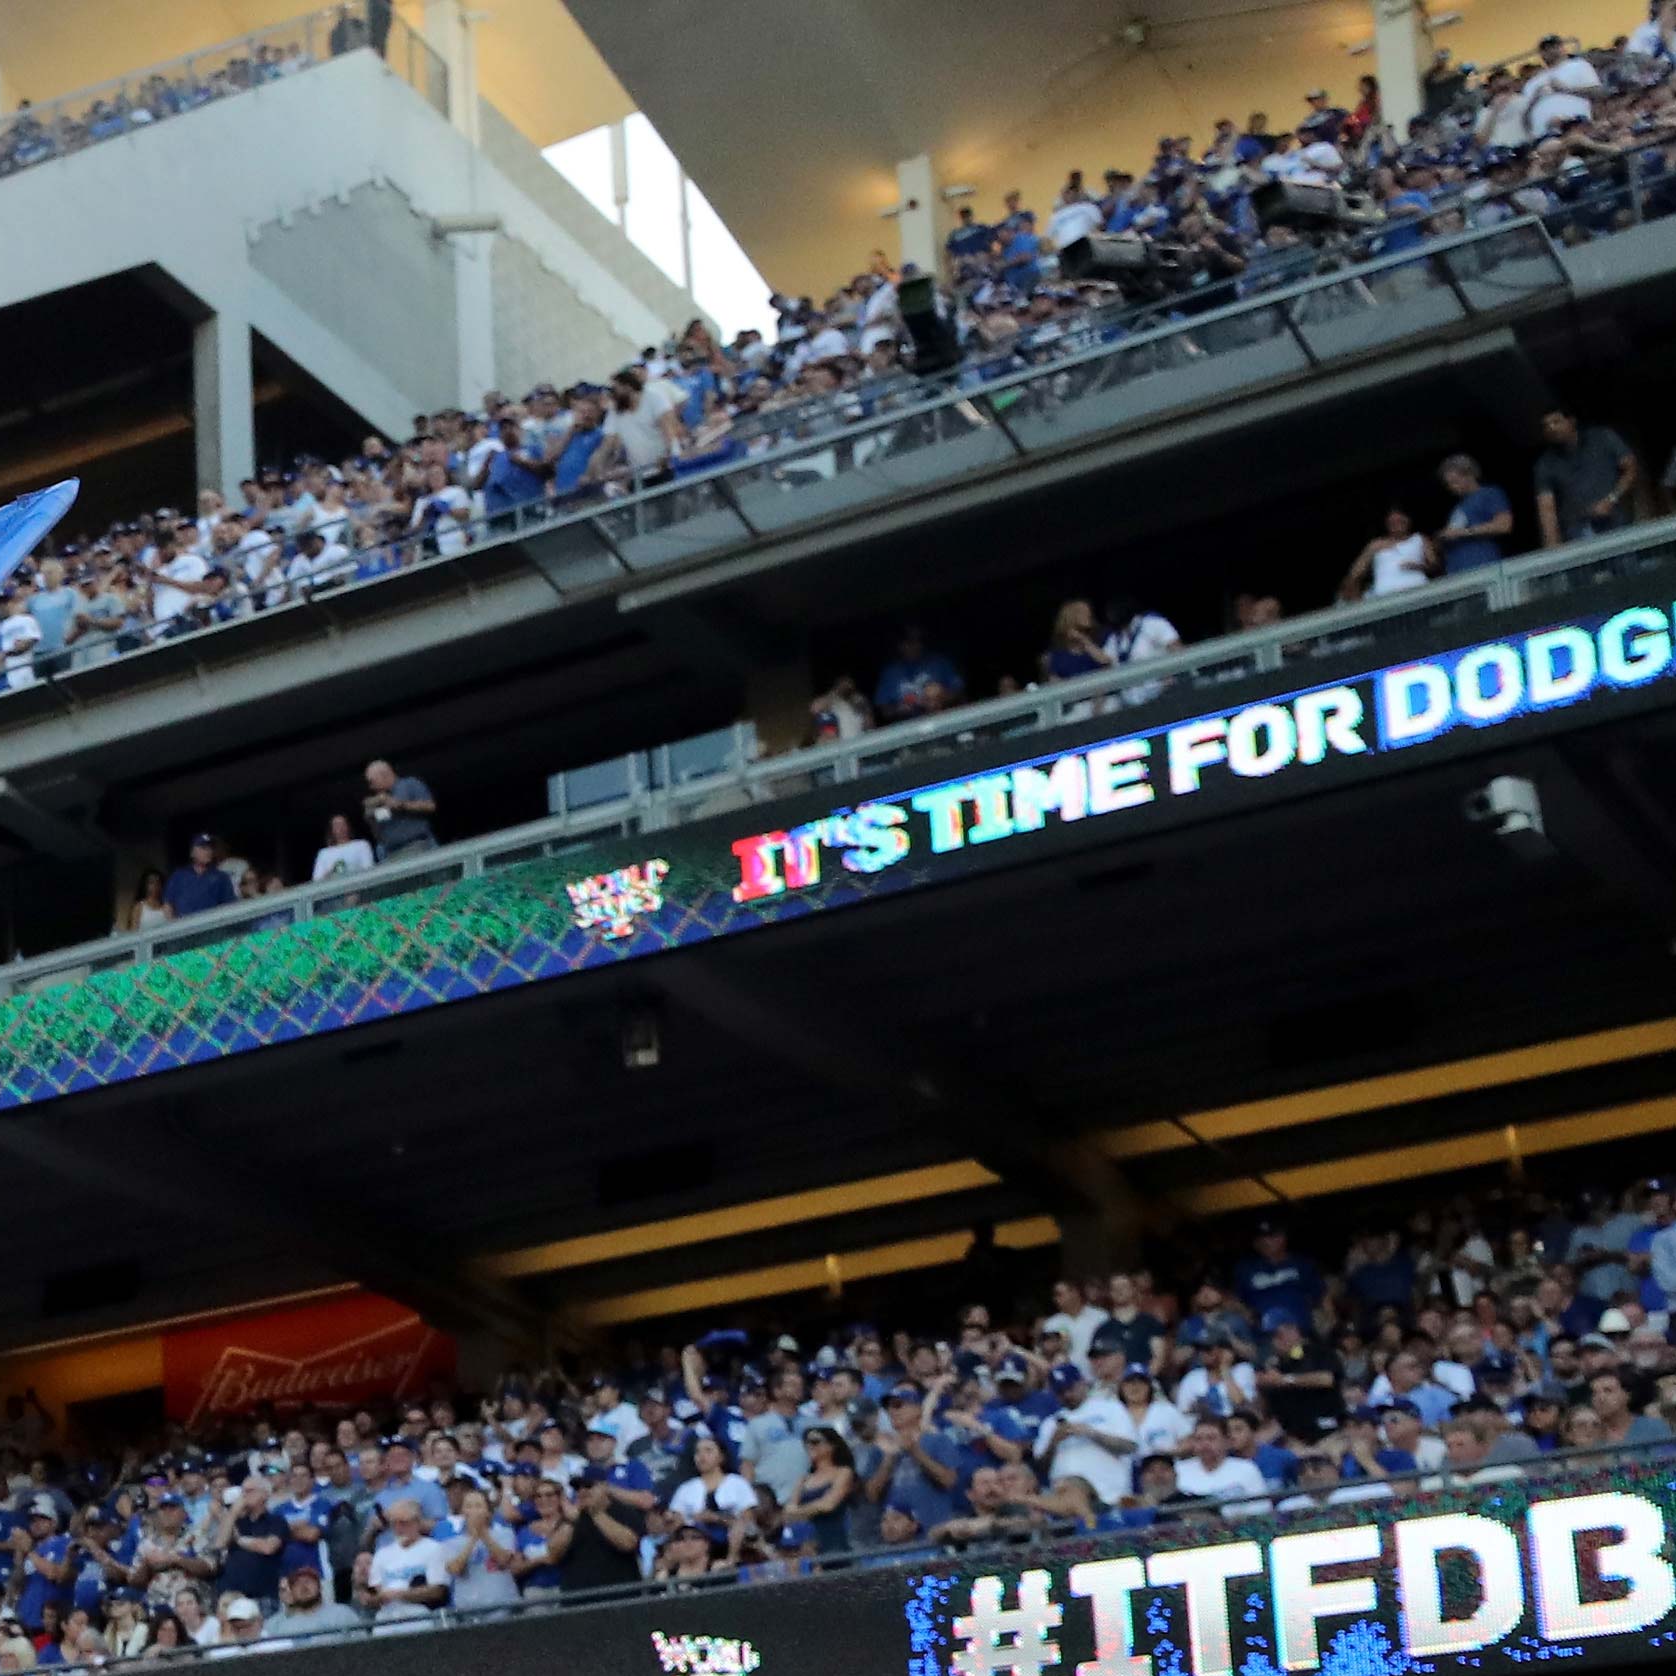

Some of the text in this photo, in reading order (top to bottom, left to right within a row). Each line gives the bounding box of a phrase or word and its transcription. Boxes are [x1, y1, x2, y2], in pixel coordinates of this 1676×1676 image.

[731, 606, 1676, 902] IT'S TIME FOR DODG
